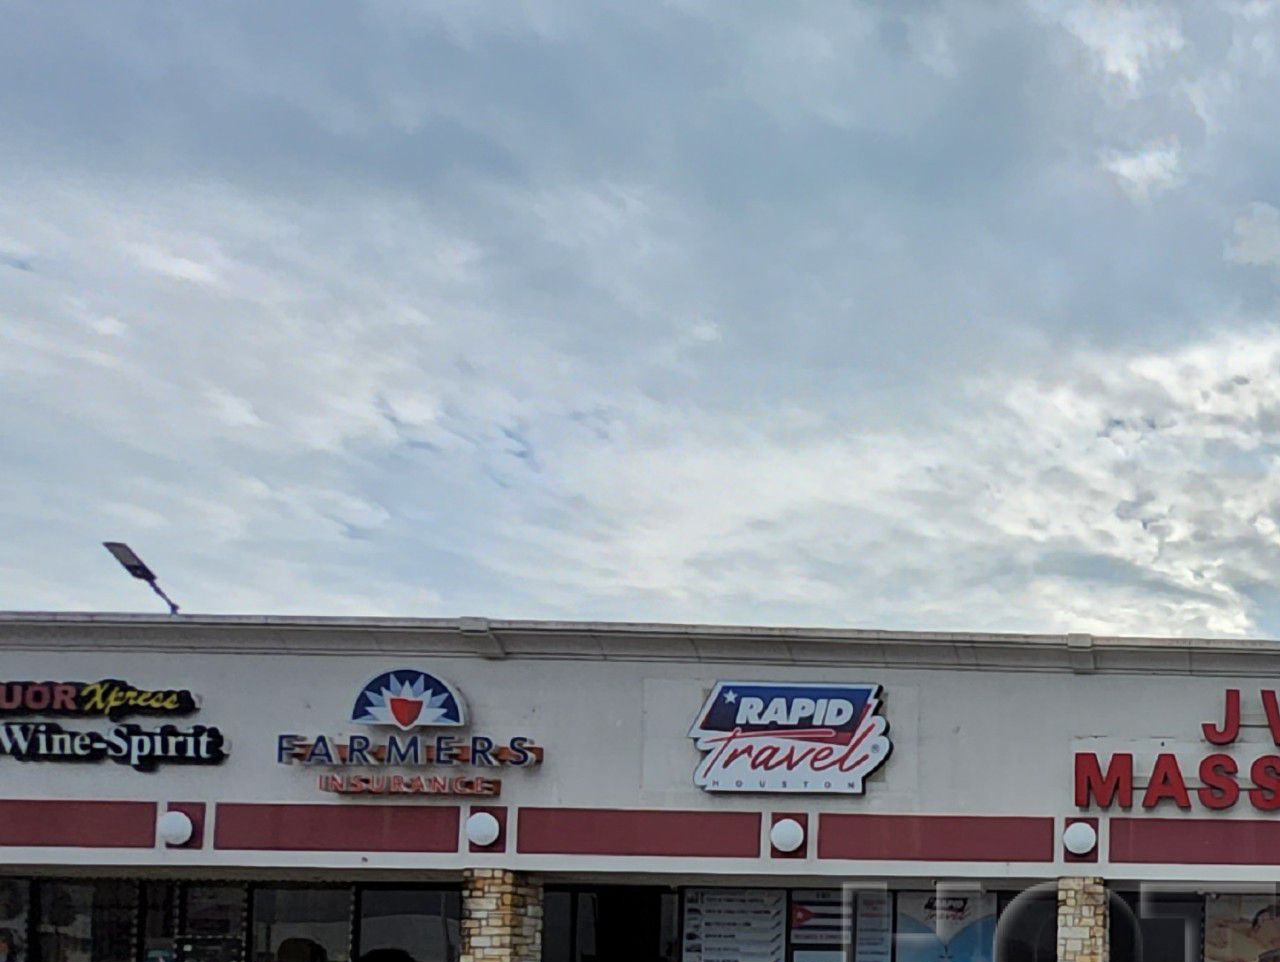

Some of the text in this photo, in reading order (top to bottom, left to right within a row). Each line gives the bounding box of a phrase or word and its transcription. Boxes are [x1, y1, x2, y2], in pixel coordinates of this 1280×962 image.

[81, 682, 180, 716] Xpress
[735, 697, 853, 725] RAPID
[277, 734, 532, 766] FARMERS
[317, 774, 492, 796] INSURANCE
[712, 780, 855, 789] HOUSTON
